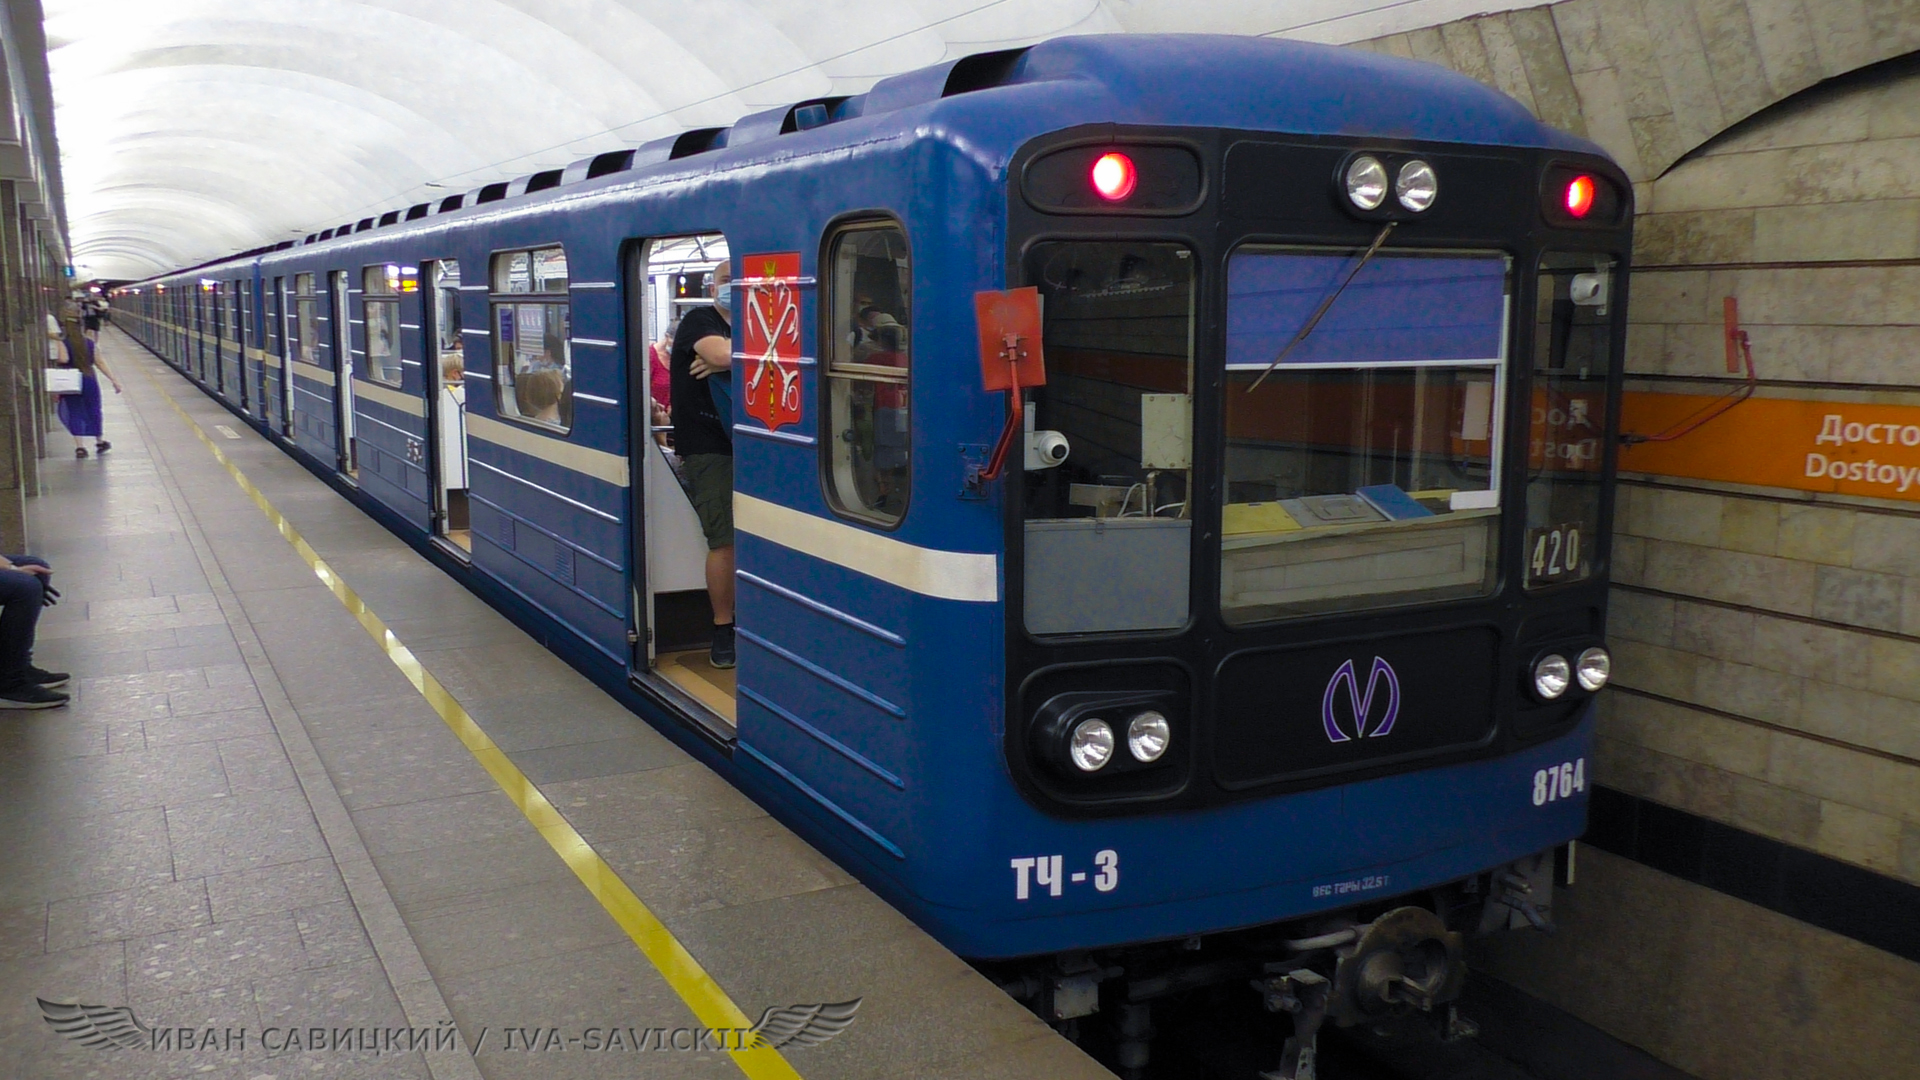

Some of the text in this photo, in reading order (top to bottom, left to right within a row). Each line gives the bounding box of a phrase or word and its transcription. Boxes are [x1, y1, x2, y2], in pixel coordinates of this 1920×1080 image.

[1815, 414, 1920, 447] Досто
[1804, 453, 1920, 493] Dostoy
[1532, 528, 1579, 577] 420
[1532, 757, 1585, 806] 8764
